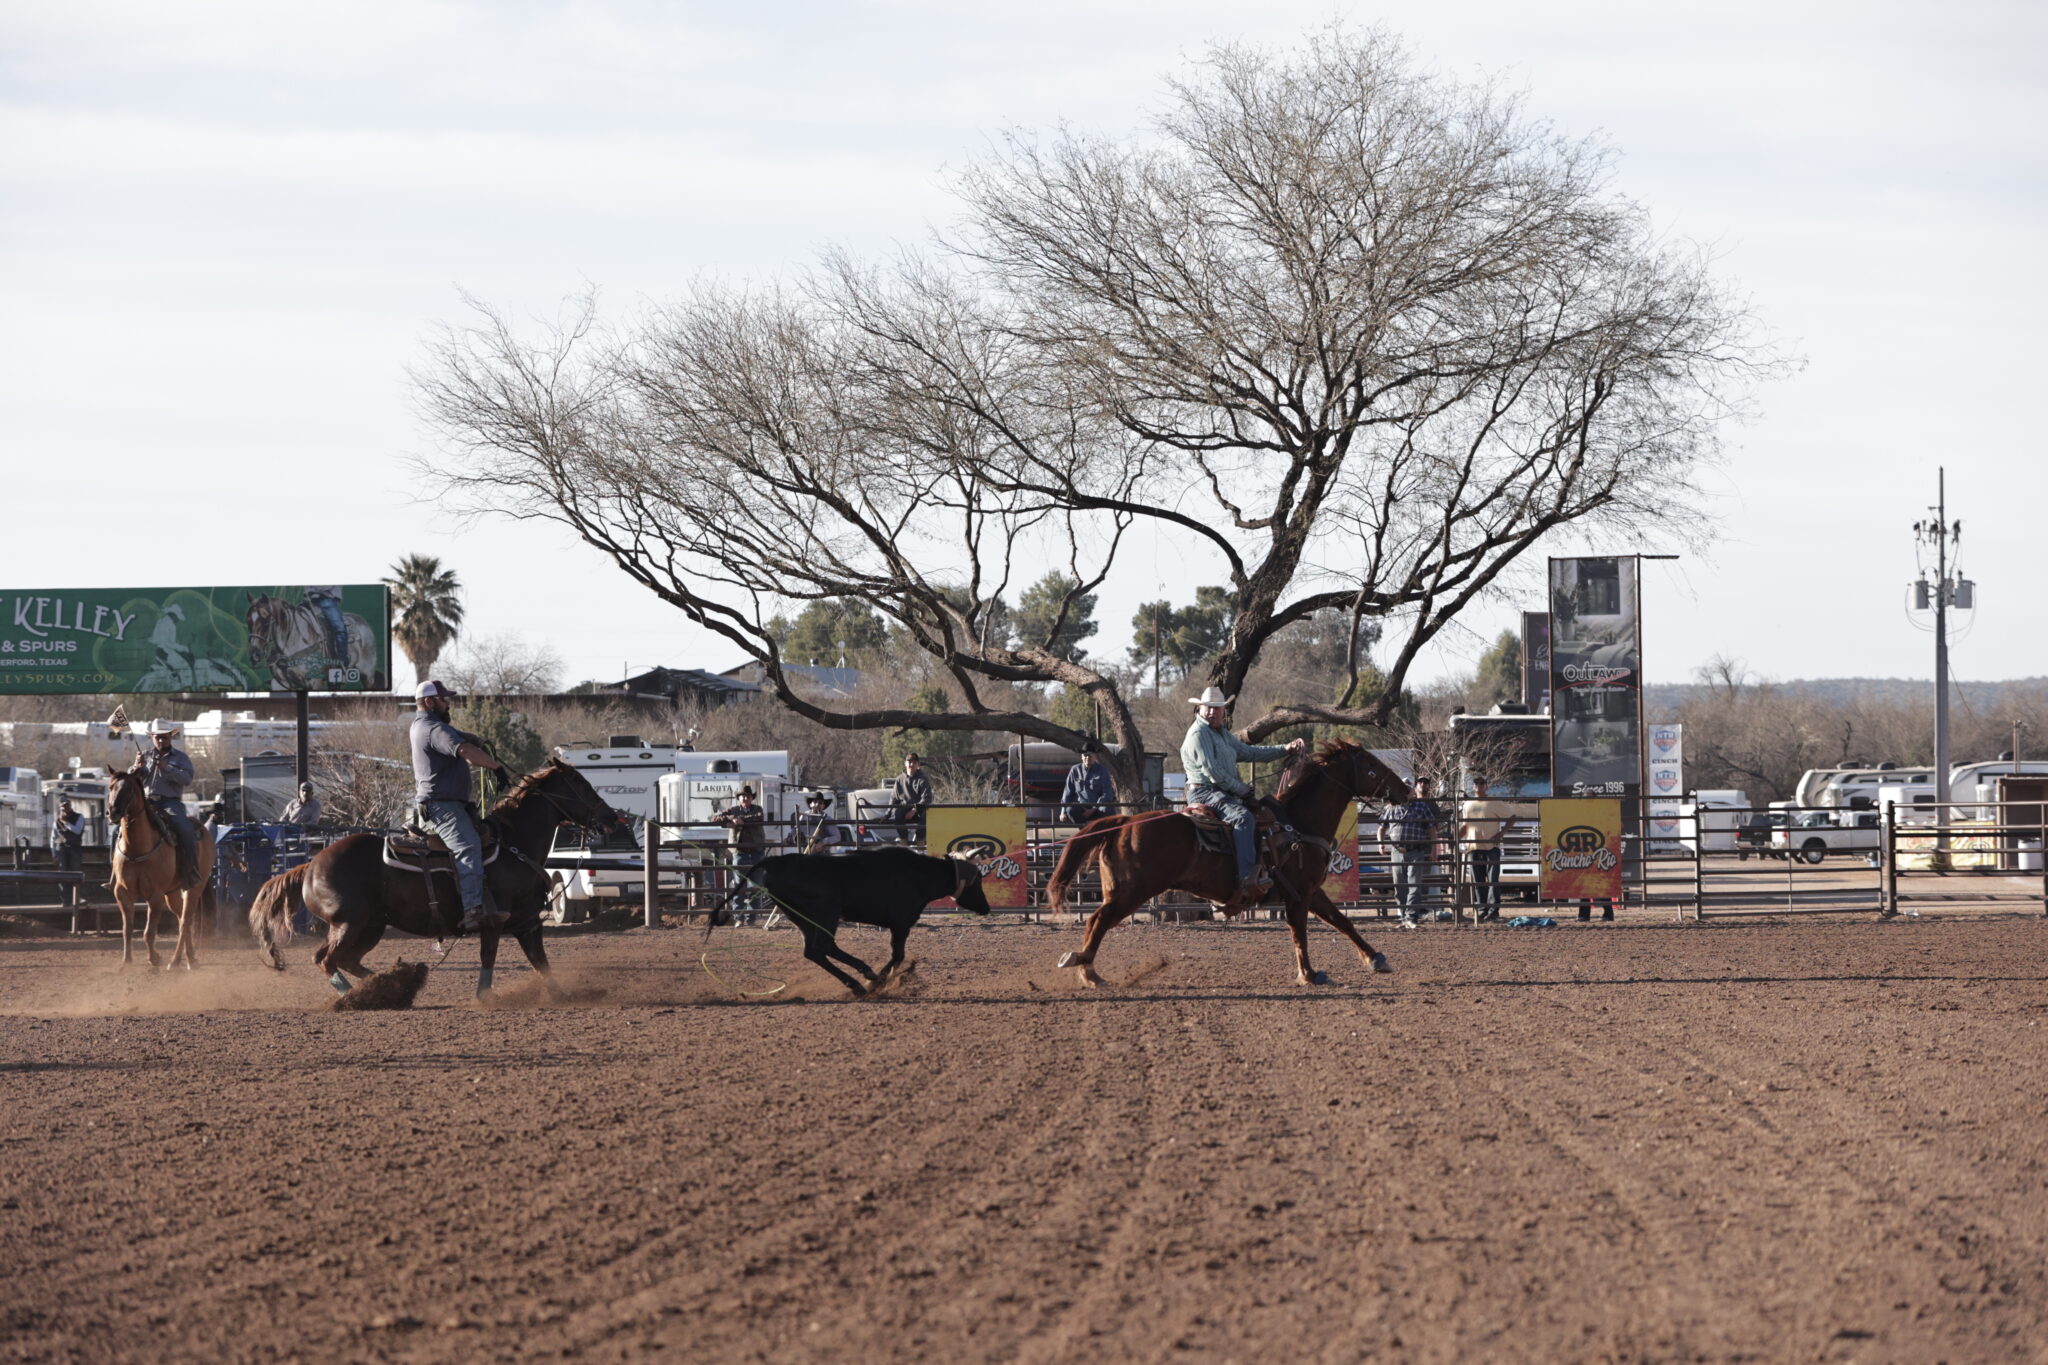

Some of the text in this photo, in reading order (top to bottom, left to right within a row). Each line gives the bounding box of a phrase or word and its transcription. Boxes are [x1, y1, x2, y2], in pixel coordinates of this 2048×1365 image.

[14, 596, 136, 641] KELLEY
[1, 640, 78, 653] & SPURS
[39, 657, 69, 667] TEXAS
[696, 782, 733, 792] LAKOTA
[1605, 781, 1624, 793] 1996
[989, 856, 1021, 880] Rio
[1328, 850, 1353, 874] Rio
[1546, 848, 1593, 871] Rancho
[1592, 847, 1617, 871] Rio
